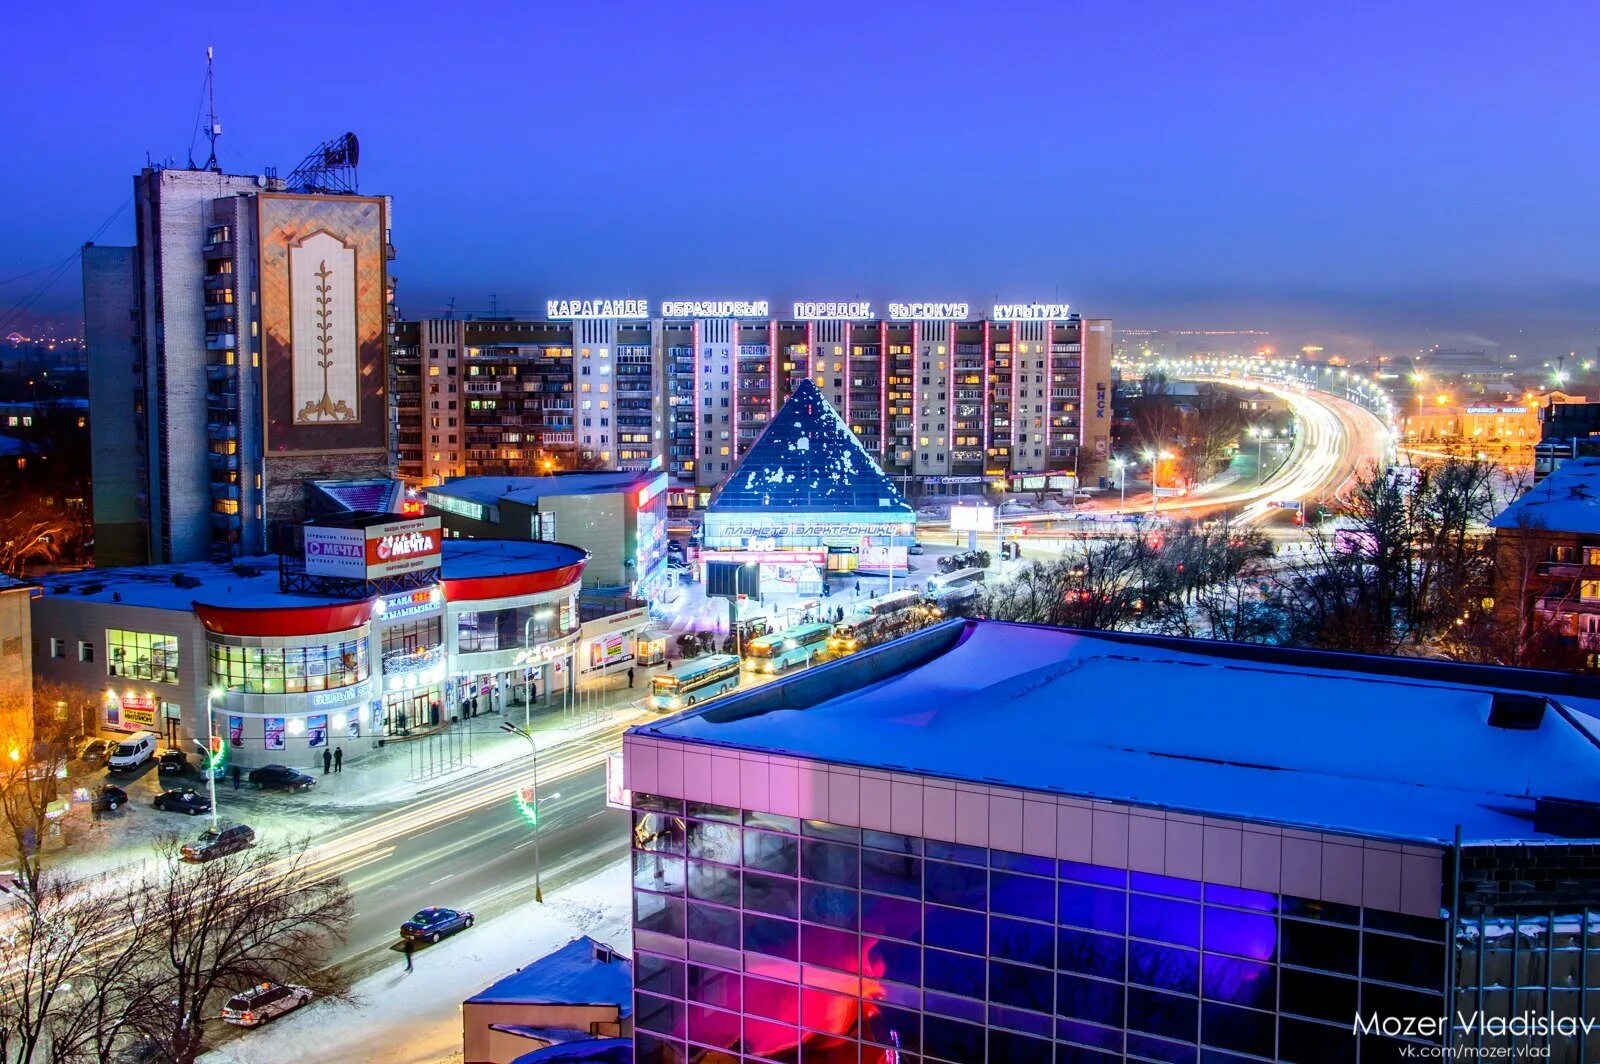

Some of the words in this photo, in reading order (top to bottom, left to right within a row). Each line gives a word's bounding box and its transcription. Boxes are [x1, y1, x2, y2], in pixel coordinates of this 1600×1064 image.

[547, 299, 648, 317] КАРАГАНДЕ
[662, 300, 769, 317] ОБРАЗЦОВЫЙ
[793, 302, 875, 319] ПОРЯДОК,
[888, 303, 969, 319] ВЫСОКУЮ
[993, 303, 1070, 320] КУЛЬТУРУ
[323, 543, 361, 557] МЕЧТА
[392, 536, 434, 555] МЕЧТА
[313, 687, 356, 705] БЕЛЫЙ
